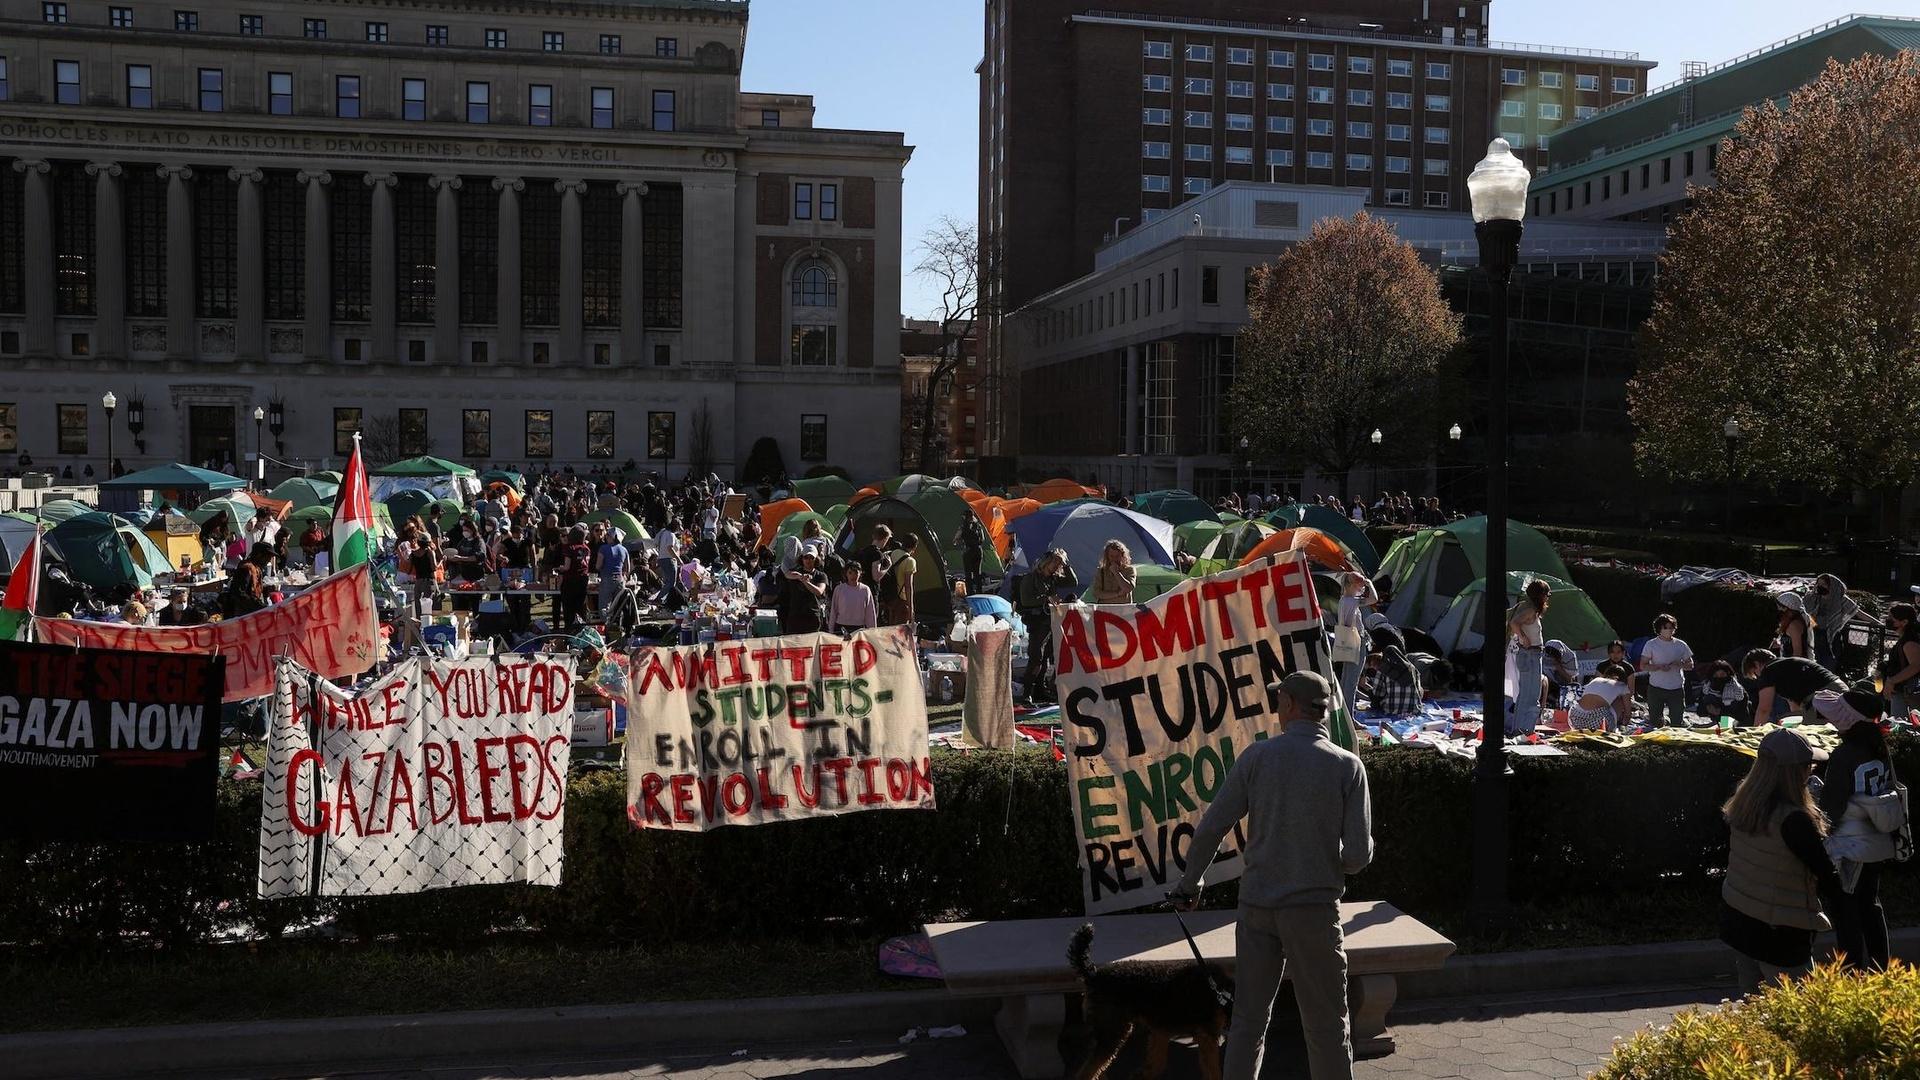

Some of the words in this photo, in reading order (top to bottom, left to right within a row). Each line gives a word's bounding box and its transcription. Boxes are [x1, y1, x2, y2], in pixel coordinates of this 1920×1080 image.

[0, 122, 109, 142] OPHOCLES
[125, 129, 190, 146] PLATO
[207, 133, 312, 150] ARISTOTLE
[326, 138, 463, 157] DEMOSTHENES
[475, 143, 544, 160] CICERO
[557, 147, 622, 163] VERGIL
[13, 651, 86, 698] THE
[95, 655, 208, 703] SIEGE
[638, 639, 878, 696] ADMITTED
[1065, 626, 1332, 758] STUDENT
[0, 696, 95, 749] GAZA
[110, 701, 204, 751] NOW
[290, 680, 407, 731] WHILE
[427, 668, 490, 719] YOU
[495, 663, 571, 715] READ
[655, 724, 786, 771] ENROLL
[811, 717, 871, 759] IN
[640, 757, 932, 826] REVOLUTION
